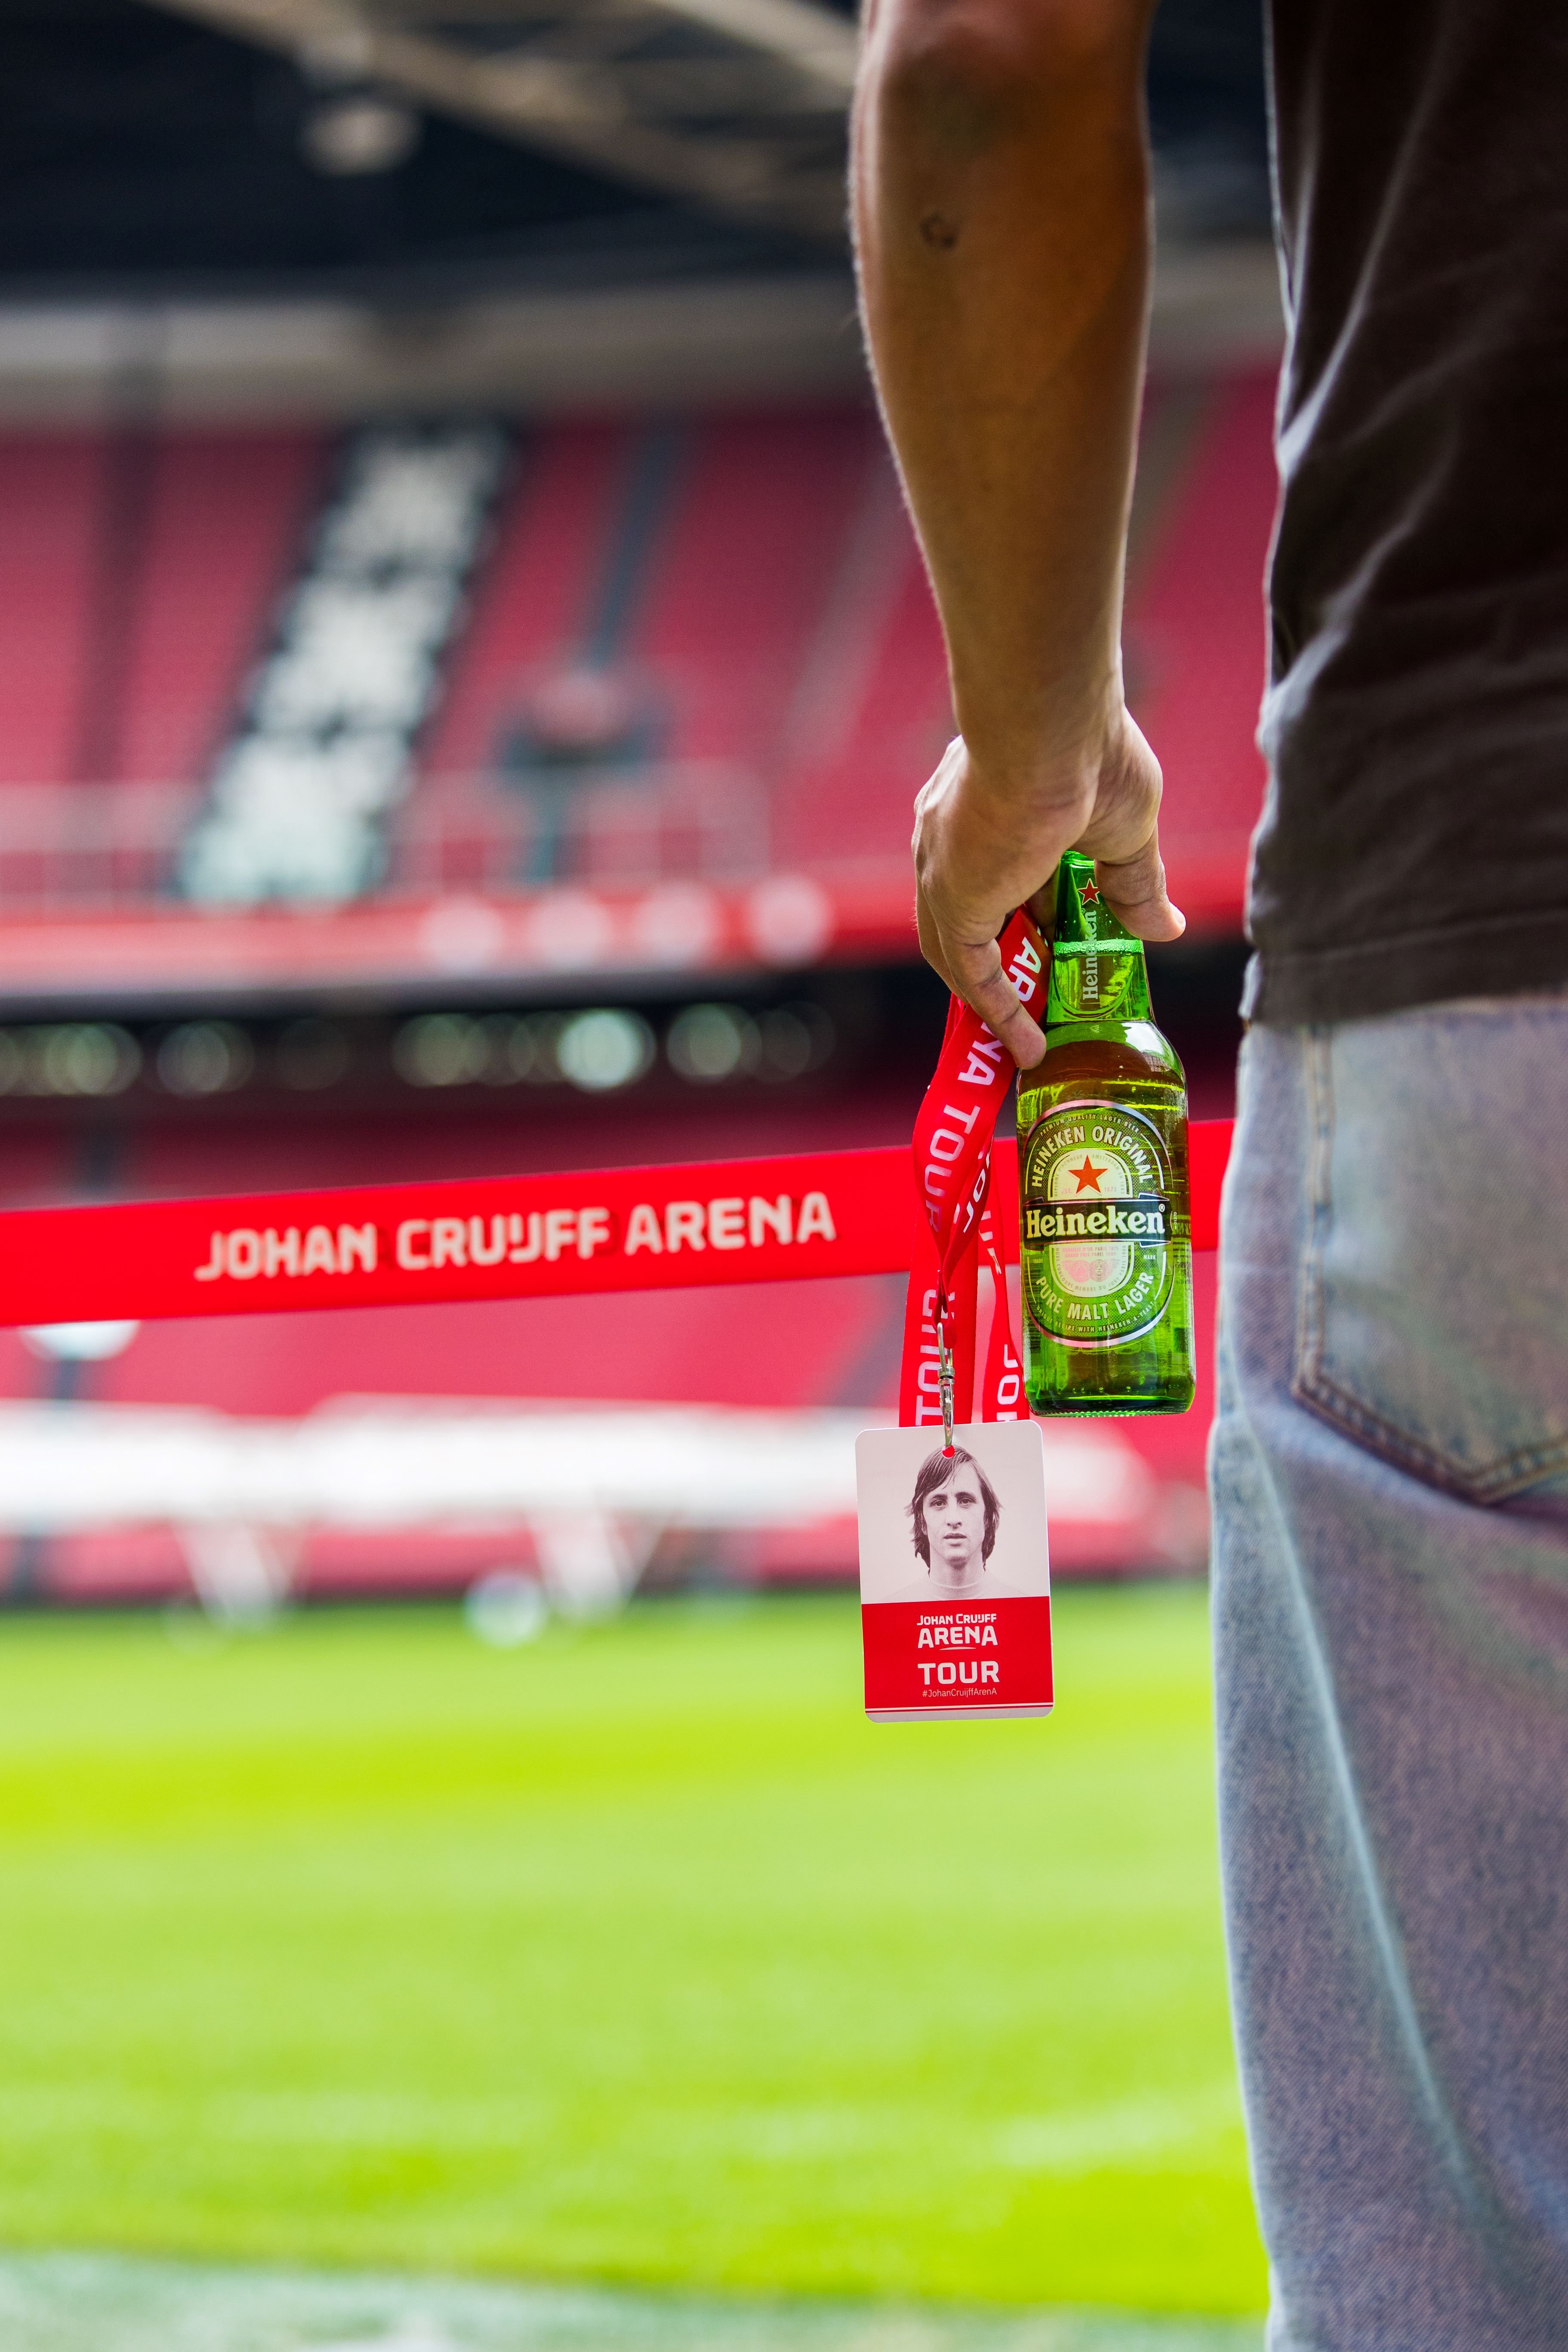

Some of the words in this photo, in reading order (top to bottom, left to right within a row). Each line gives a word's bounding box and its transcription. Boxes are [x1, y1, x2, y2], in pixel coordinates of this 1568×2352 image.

[958, 936, 1042, 1086] ARNA
[1040, 1119, 1065, 1136] PREMIUM
[1100, 1115, 1121, 1124] LAGER
[1124, 1122, 1139, 1133] BEER
[1032, 1125, 1085, 1187] HEINEKEN
[1092, 1125, 1153, 1183] ORIGINAL
[194, 1223, 377, 1281] JOHAN
[625, 1191, 836, 1255] ARENA
[1057, 1264, 1073, 1288] CONCOURS
[1109, 1277, 1120, 1287] JURY
[1035, 1276, 1064, 1314] PURE
[1067, 1302, 1108, 1320] MALT
[1114, 1271, 1154, 1315] LAGER
[1037, 1305, 1053, 1324] UNIQUE
[1055, 1321, 1075, 1332] RECIPE
[1098, 1319, 1131, 1332] HEINEKEN
[916, 1615, 953, 1626] JOHAN
[918, 1625, 998, 1648] ARENA
[917, 1660, 1000, 1685] TOUR
[922, 1687, 997, 1698] #JohanCruijffArenA
